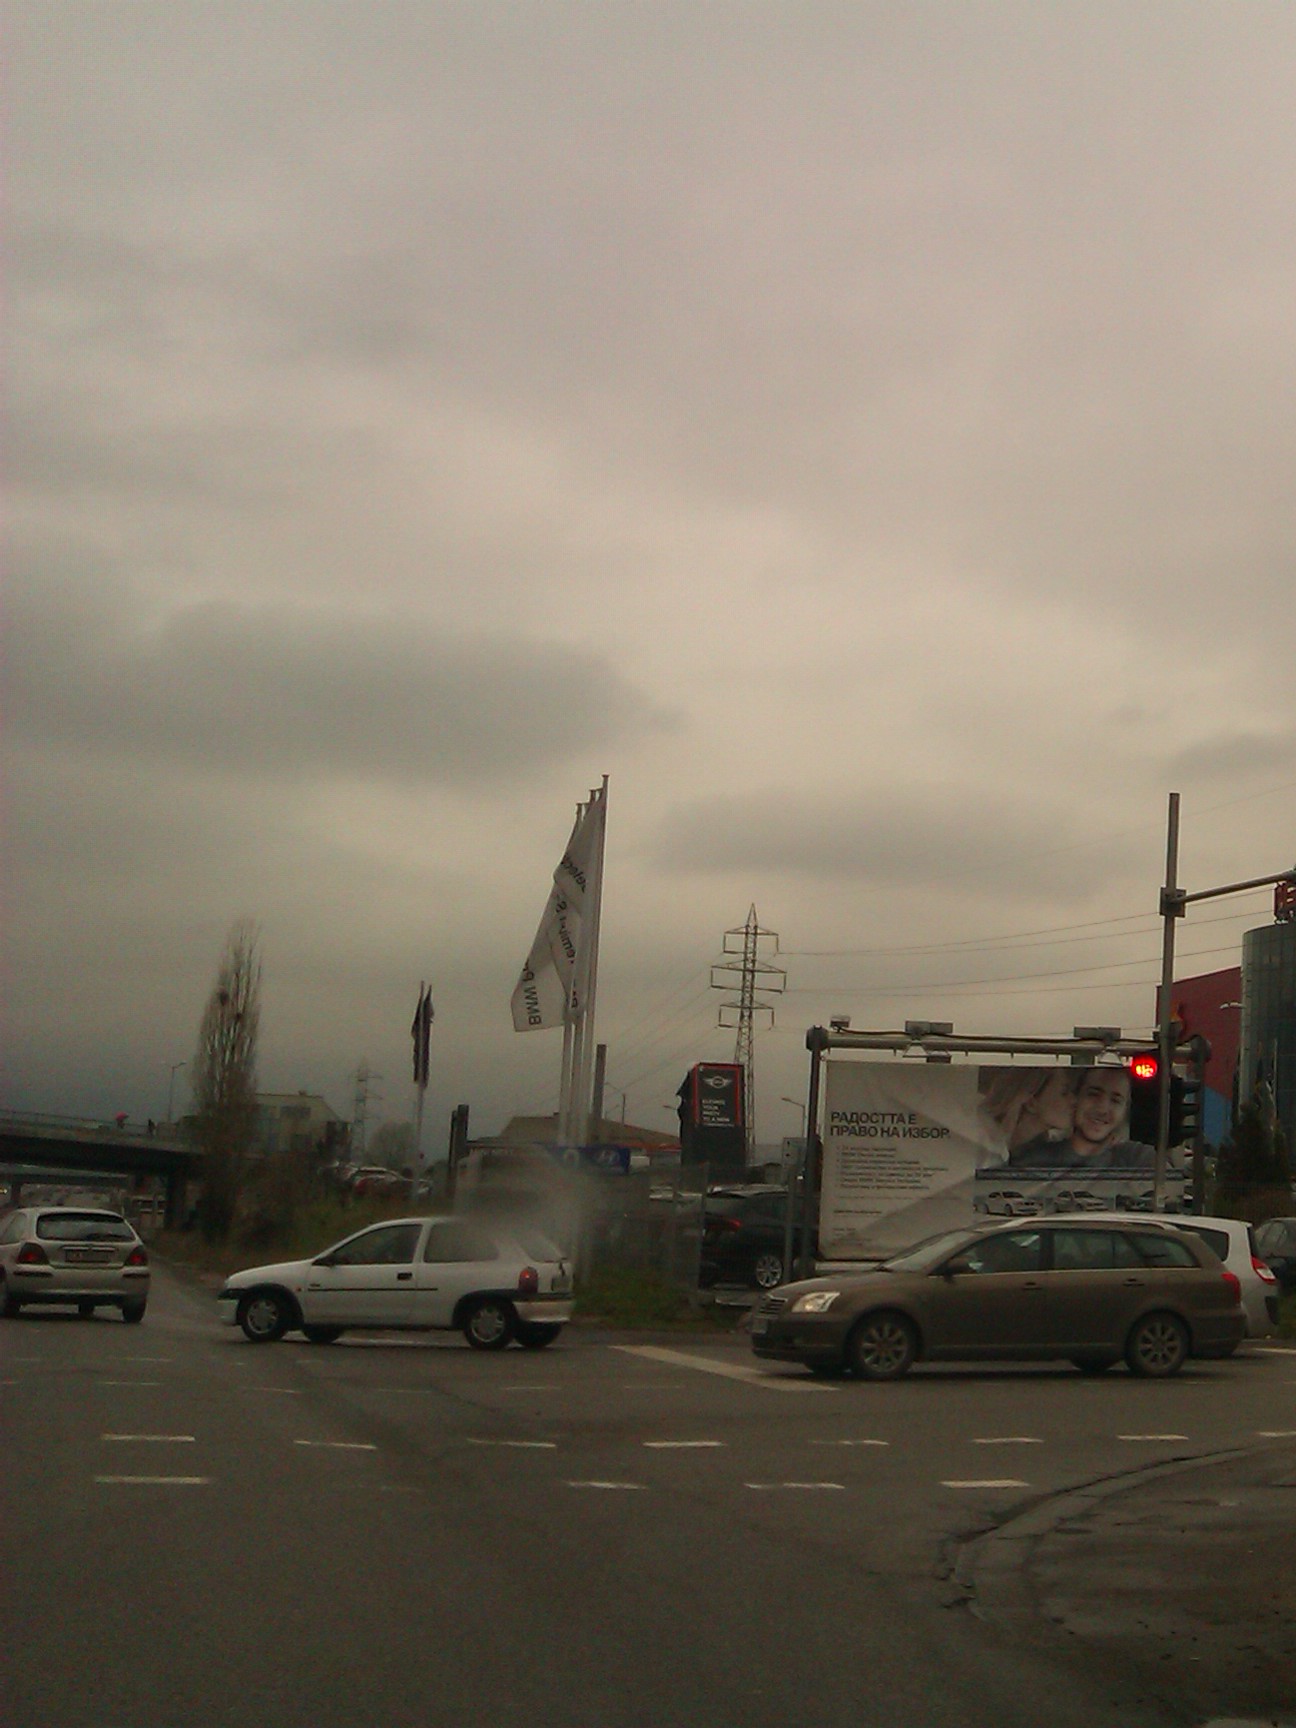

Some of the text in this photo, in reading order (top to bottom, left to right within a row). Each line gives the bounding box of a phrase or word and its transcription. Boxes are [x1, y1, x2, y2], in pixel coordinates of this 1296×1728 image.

[830, 1111, 917, 1125] РАДОСТТА Е
[830, 1125, 878, 1138] ПРАВО
[880, 1127, 900, 1139] НА
